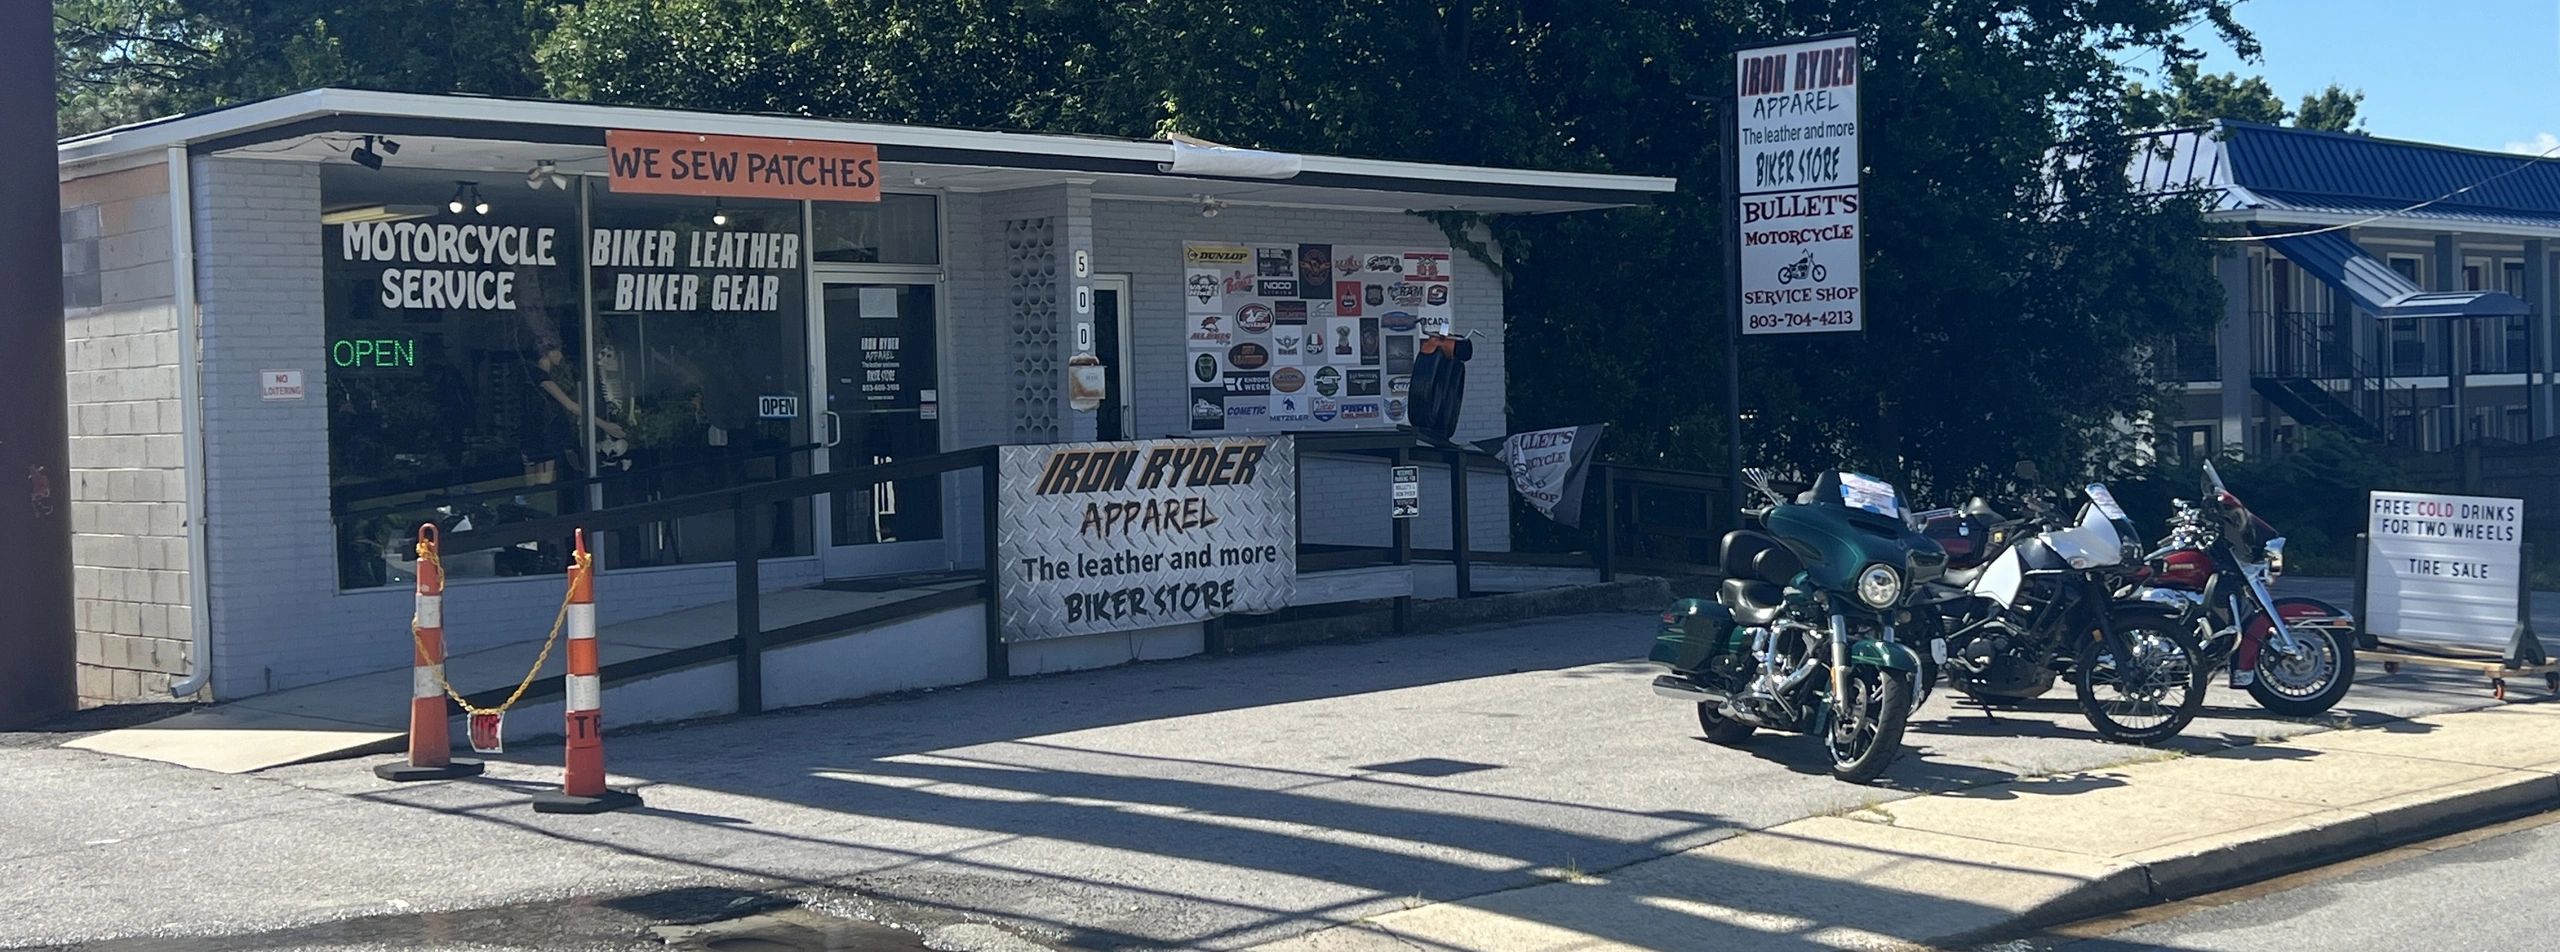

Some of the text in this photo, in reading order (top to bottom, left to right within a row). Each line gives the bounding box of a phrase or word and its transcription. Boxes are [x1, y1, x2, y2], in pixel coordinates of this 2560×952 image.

[1741, 46, 1857, 97] IRON RYDER
[1753, 90, 1839, 121] APPAREL
[1742, 122, 1855, 146] The leather and more
[610, 146, 875, 189] WE SEW PATCHES
[1756, 146, 1840, 188] BIKER STORE
[1743, 194, 1858, 224] BULLET'S
[342, 221, 556, 267] MOTORCYCLE
[591, 229, 799, 269] BIKER LEATHER
[1745, 225, 1854, 246] MOTORCYCLE
[1199, 252, 1248, 260] DUNLOP
[381, 269, 517, 310] SERVICE
[614, 273, 780, 312] BIKER GEAR
[1744, 287, 1858, 306] SERVICE SHOP
[1750, 311, 1853, 329] 803-704-4213
[334, 339, 414, 367] OPEN
[861, 337, 900, 350] IRON RYDER
[263, 386, 302, 396] LOITERING
[276, 374, 289, 384] NO
[762, 398, 795, 415] OPEN
[1227, 406, 1267, 415] COMETIC
[1036, 441, 1269, 495] IRON RYDER
[1080, 496, 1220, 539] APPAREL
[2374, 499, 2515, 522] FREE COLD DRINKS
[2382, 518, 2513, 541] FOR TWO WHEELS
[1022, 543, 1276, 582] The leather and more
[2409, 558, 2488, 579] TIRE SALE
[1064, 578, 1235, 623] BIKER STORE
